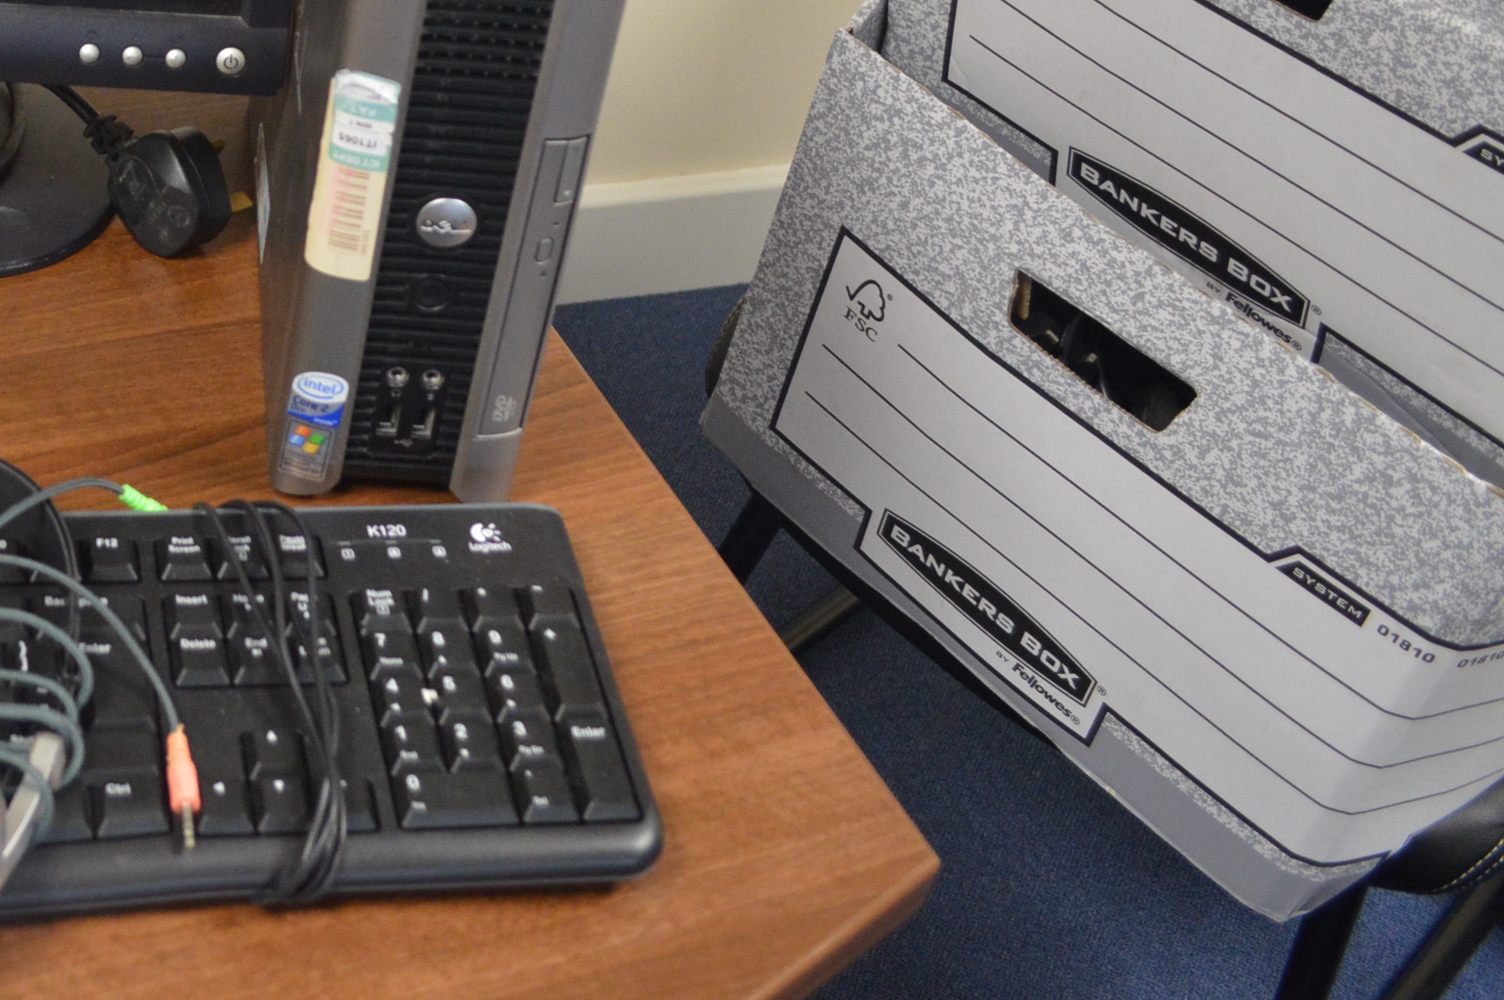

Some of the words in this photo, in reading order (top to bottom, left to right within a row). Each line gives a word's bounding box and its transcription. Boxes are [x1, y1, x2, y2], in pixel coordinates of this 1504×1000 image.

[1080, 162, 1218, 262] BANKERS
[1227, 258, 1294, 313] BOX
[843, 305, 878, 342] FSC
[366, 524, 406, 538] K120
[468, 540, 512, 552] Logitech
[890, 524, 1016, 634] BANKERS
[1020, 631, 1081, 690] BOX
[1292, 567, 1363, 620] SYSTEM
[1376, 624, 1436, 664] 01810
